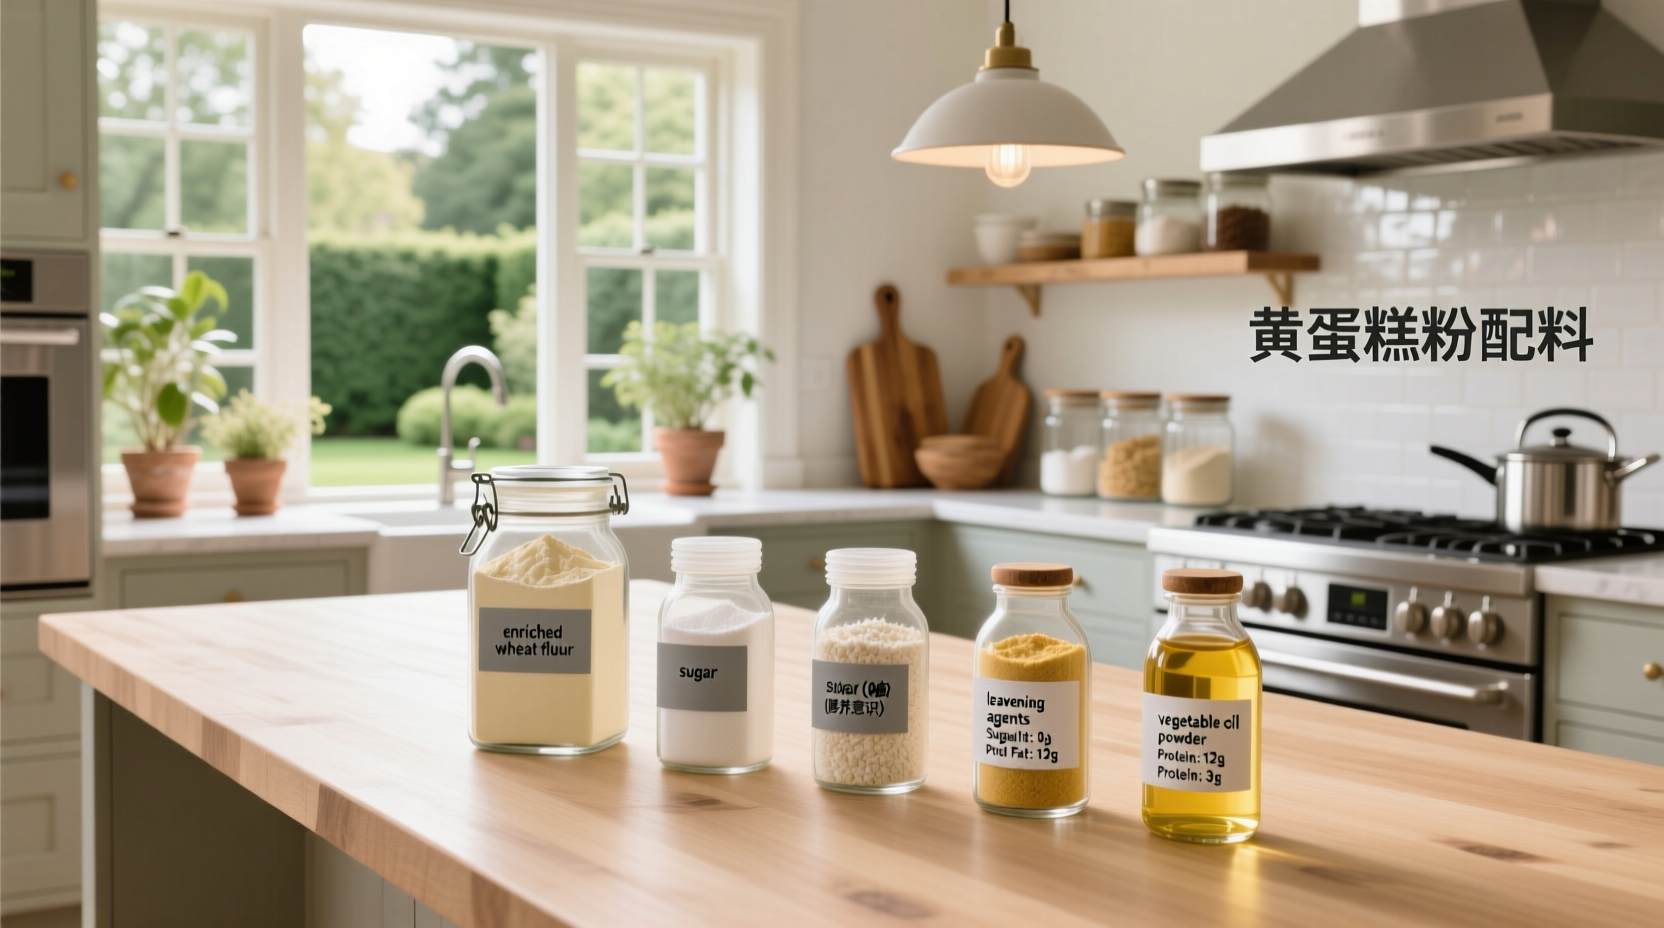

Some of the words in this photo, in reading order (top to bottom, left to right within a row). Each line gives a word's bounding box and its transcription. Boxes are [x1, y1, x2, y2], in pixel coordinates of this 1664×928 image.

[503, 624, 563, 639] enriched
[495, 640, 537, 656] wheat
[679, 666, 718, 682] sugar
[987, 691, 1045, 713] leavening
[987, 712, 1030, 728] agents
[1158, 714, 1220, 730] vegetable
[1158, 731, 1207, 746] powder
[1037, 748, 1058, 764] 12g
[1203, 751, 1225, 768] 12g
[1206, 769, 1222, 786] 3g
